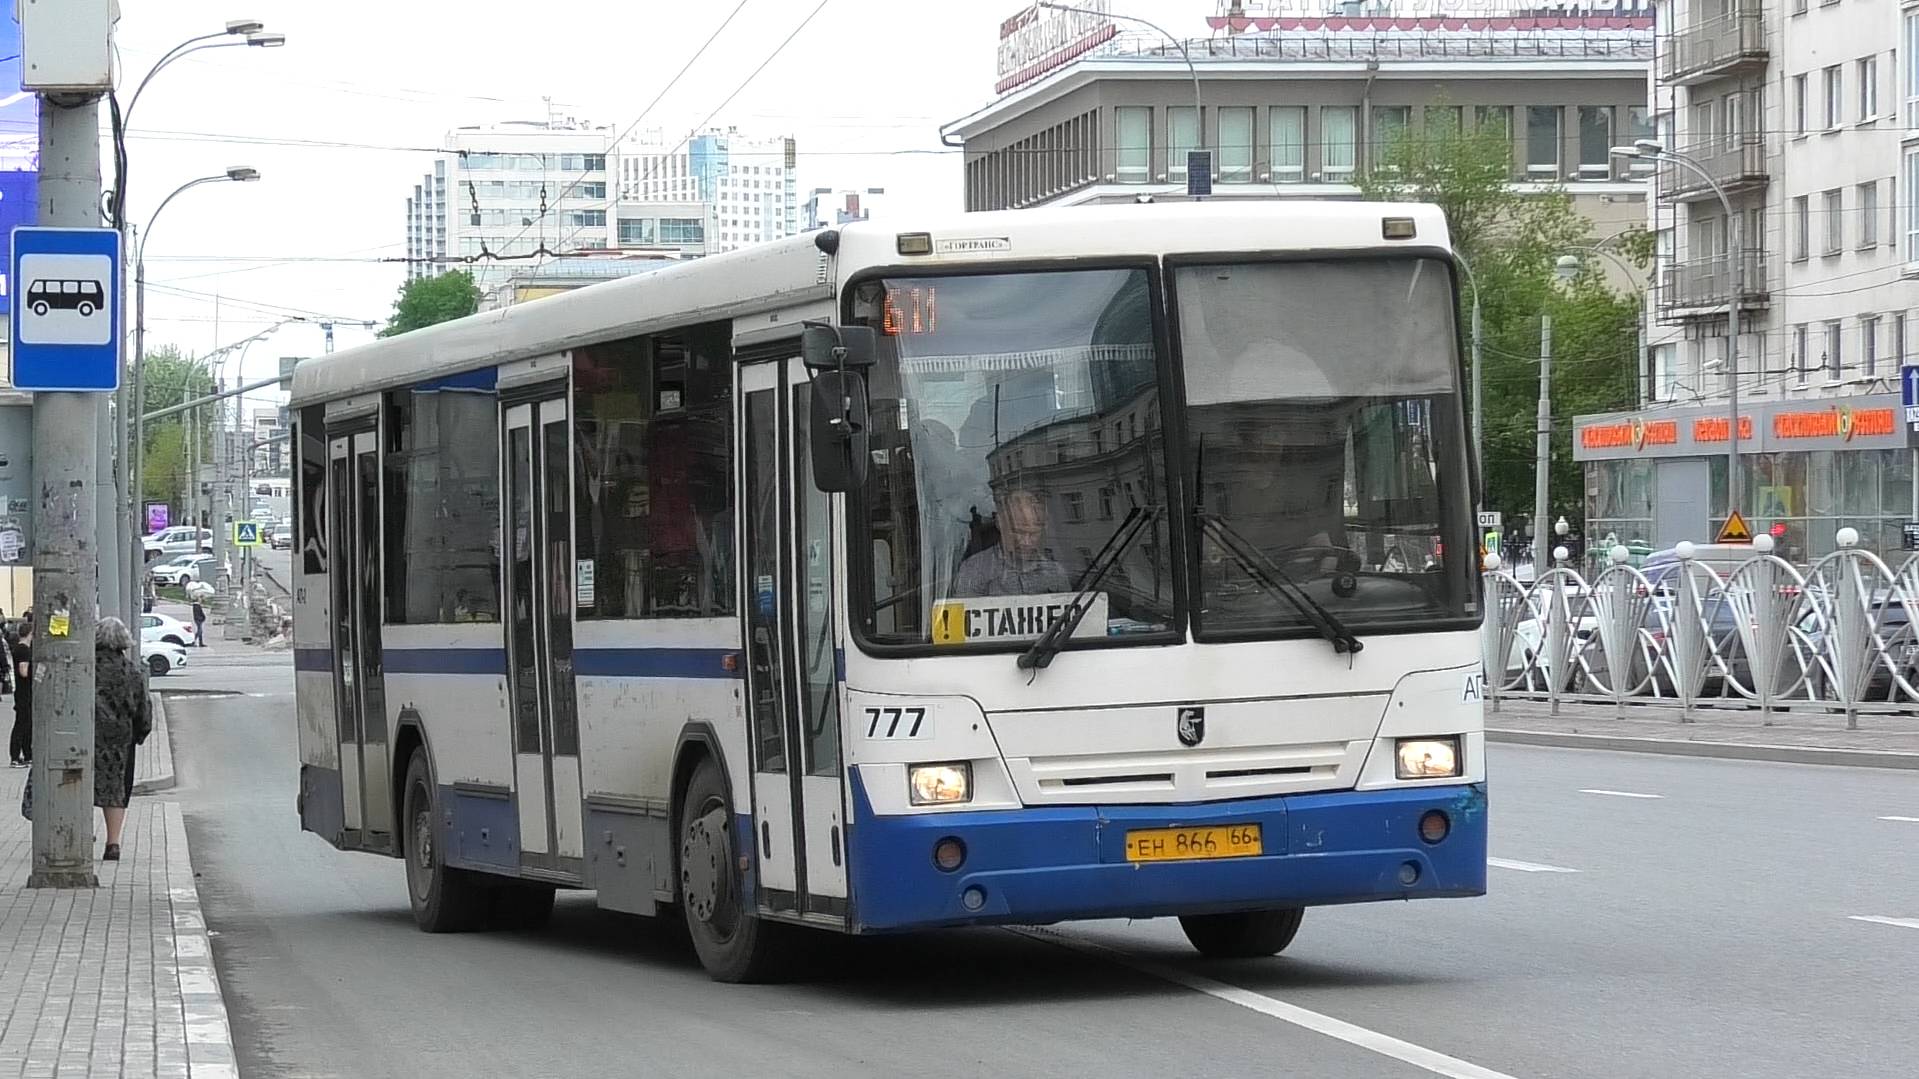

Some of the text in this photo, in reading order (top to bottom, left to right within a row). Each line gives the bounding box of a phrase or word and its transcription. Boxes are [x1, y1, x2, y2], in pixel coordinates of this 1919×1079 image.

[865, 708, 925, 737] 777
[1138, 827, 1252, 856] ЕН 866 66
